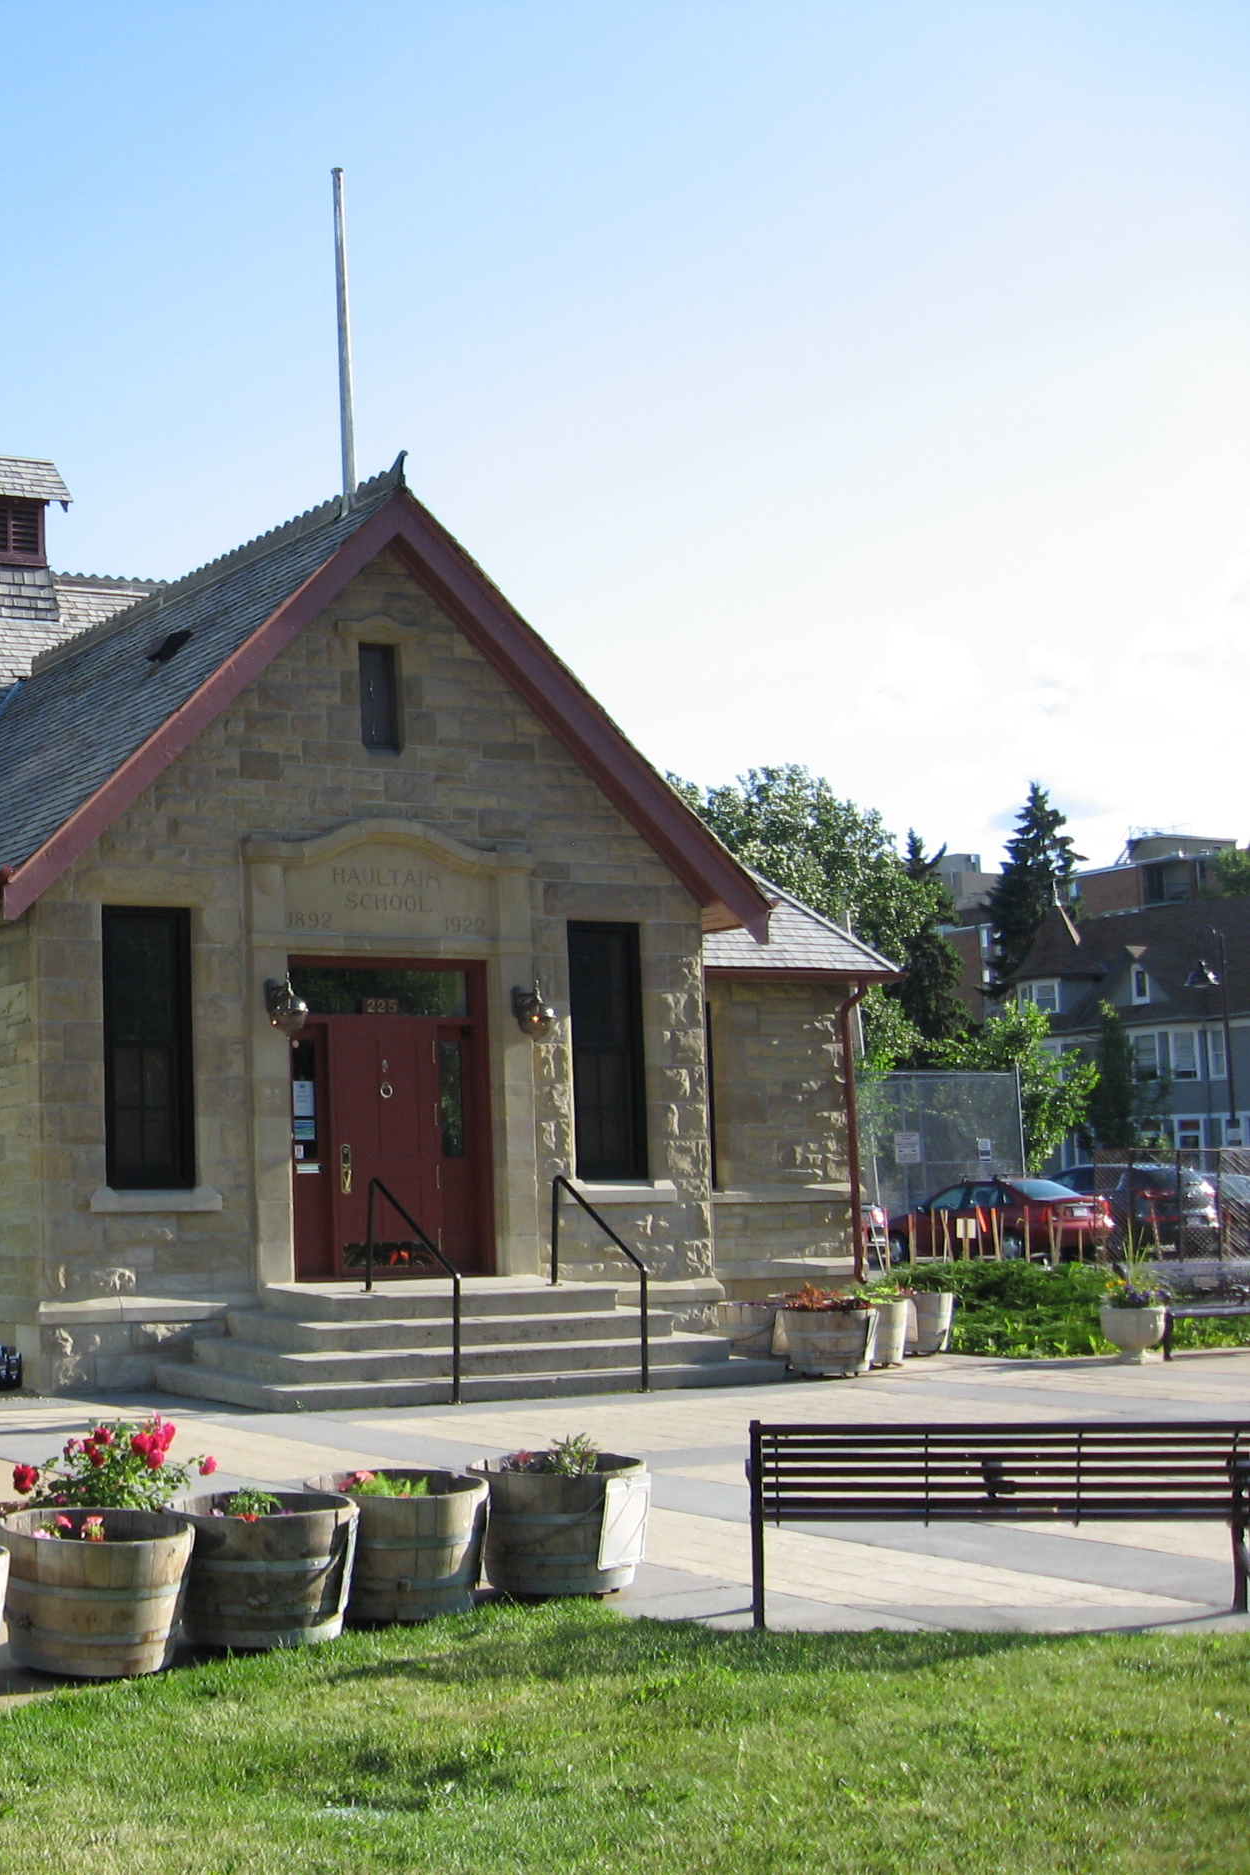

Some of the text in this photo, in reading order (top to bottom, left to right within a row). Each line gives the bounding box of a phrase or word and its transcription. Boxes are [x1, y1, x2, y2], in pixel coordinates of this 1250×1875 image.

[333, 867, 441, 888] HAULTAIN
[285, 911, 485, 933] 1892 1922
[367, 999, 397, 1013] 225
